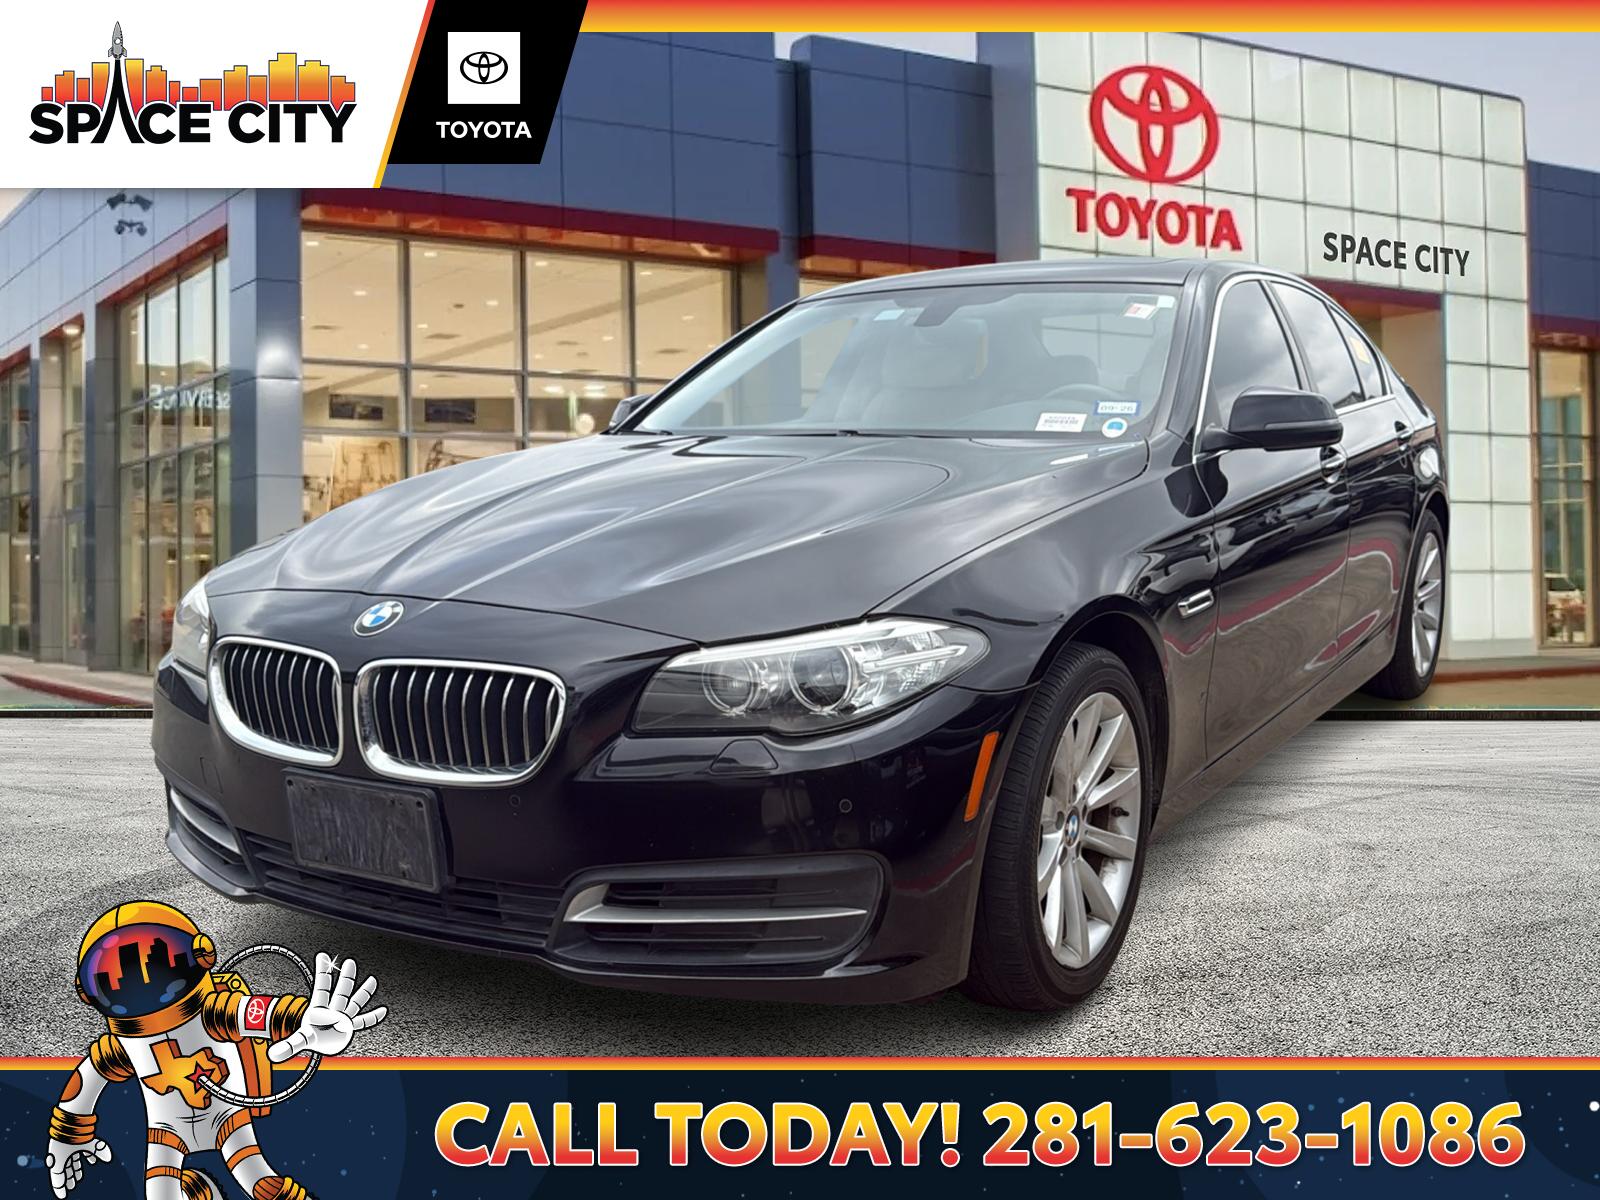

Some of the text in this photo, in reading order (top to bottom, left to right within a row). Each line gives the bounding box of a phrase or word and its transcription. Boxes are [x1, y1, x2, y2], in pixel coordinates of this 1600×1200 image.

[1066, 188, 1242, 251] TOYOTA
[1323, 232, 1470, 277] SPACE CITY
